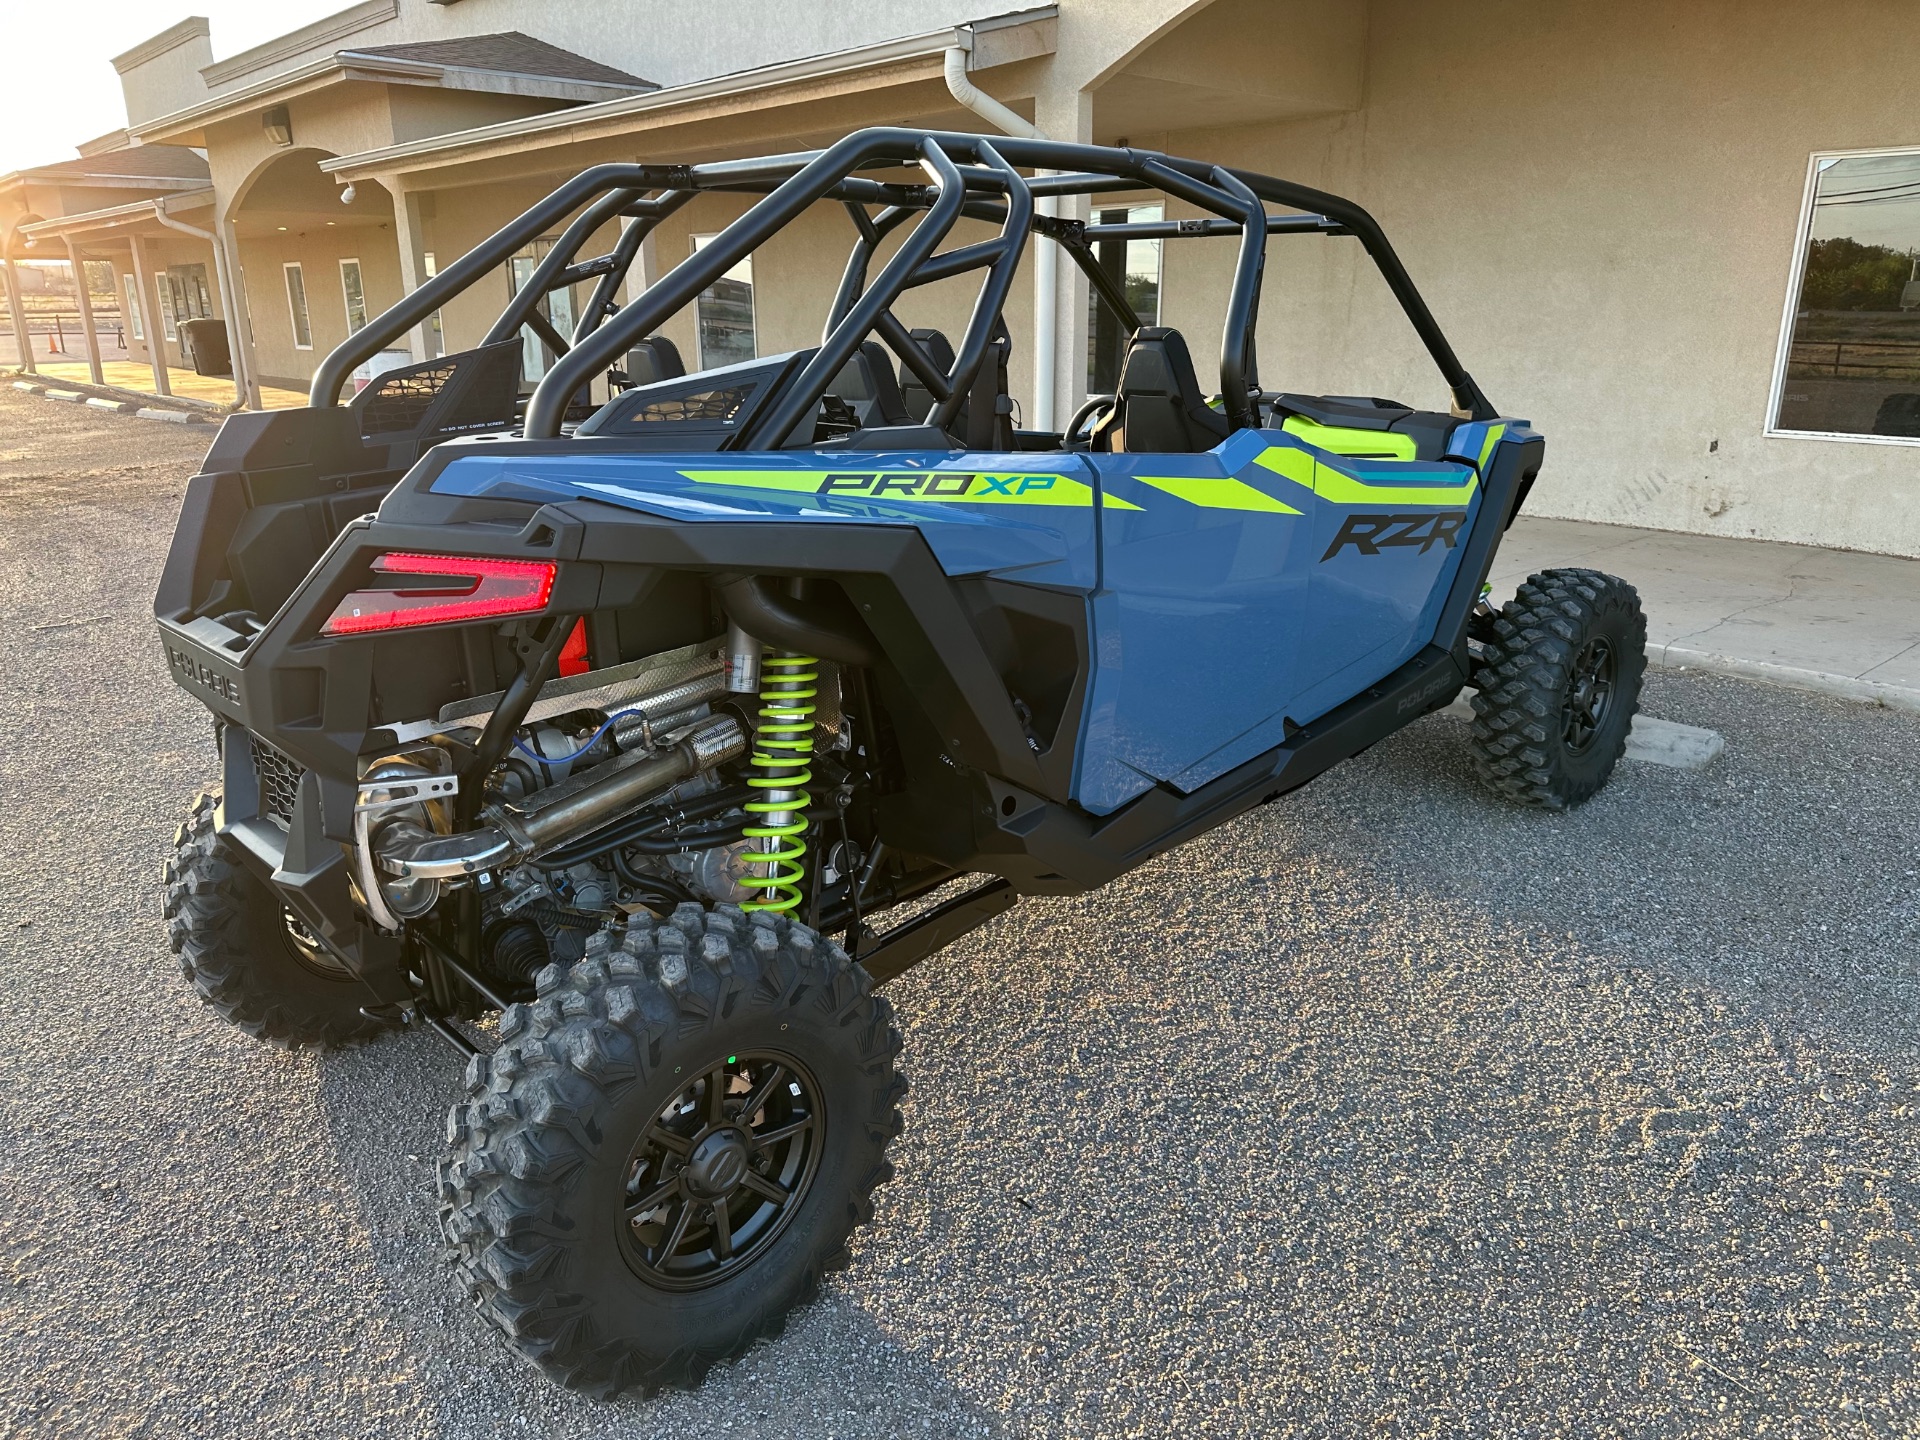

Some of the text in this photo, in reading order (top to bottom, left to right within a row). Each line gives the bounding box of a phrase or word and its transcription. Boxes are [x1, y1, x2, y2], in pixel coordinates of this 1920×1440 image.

[816, 474, 1057, 496] PRO XP
[1318, 511, 1468, 563] RZR
[168, 646, 241, 706] POLARIS
[1397, 671, 1452, 715] POLARIS
